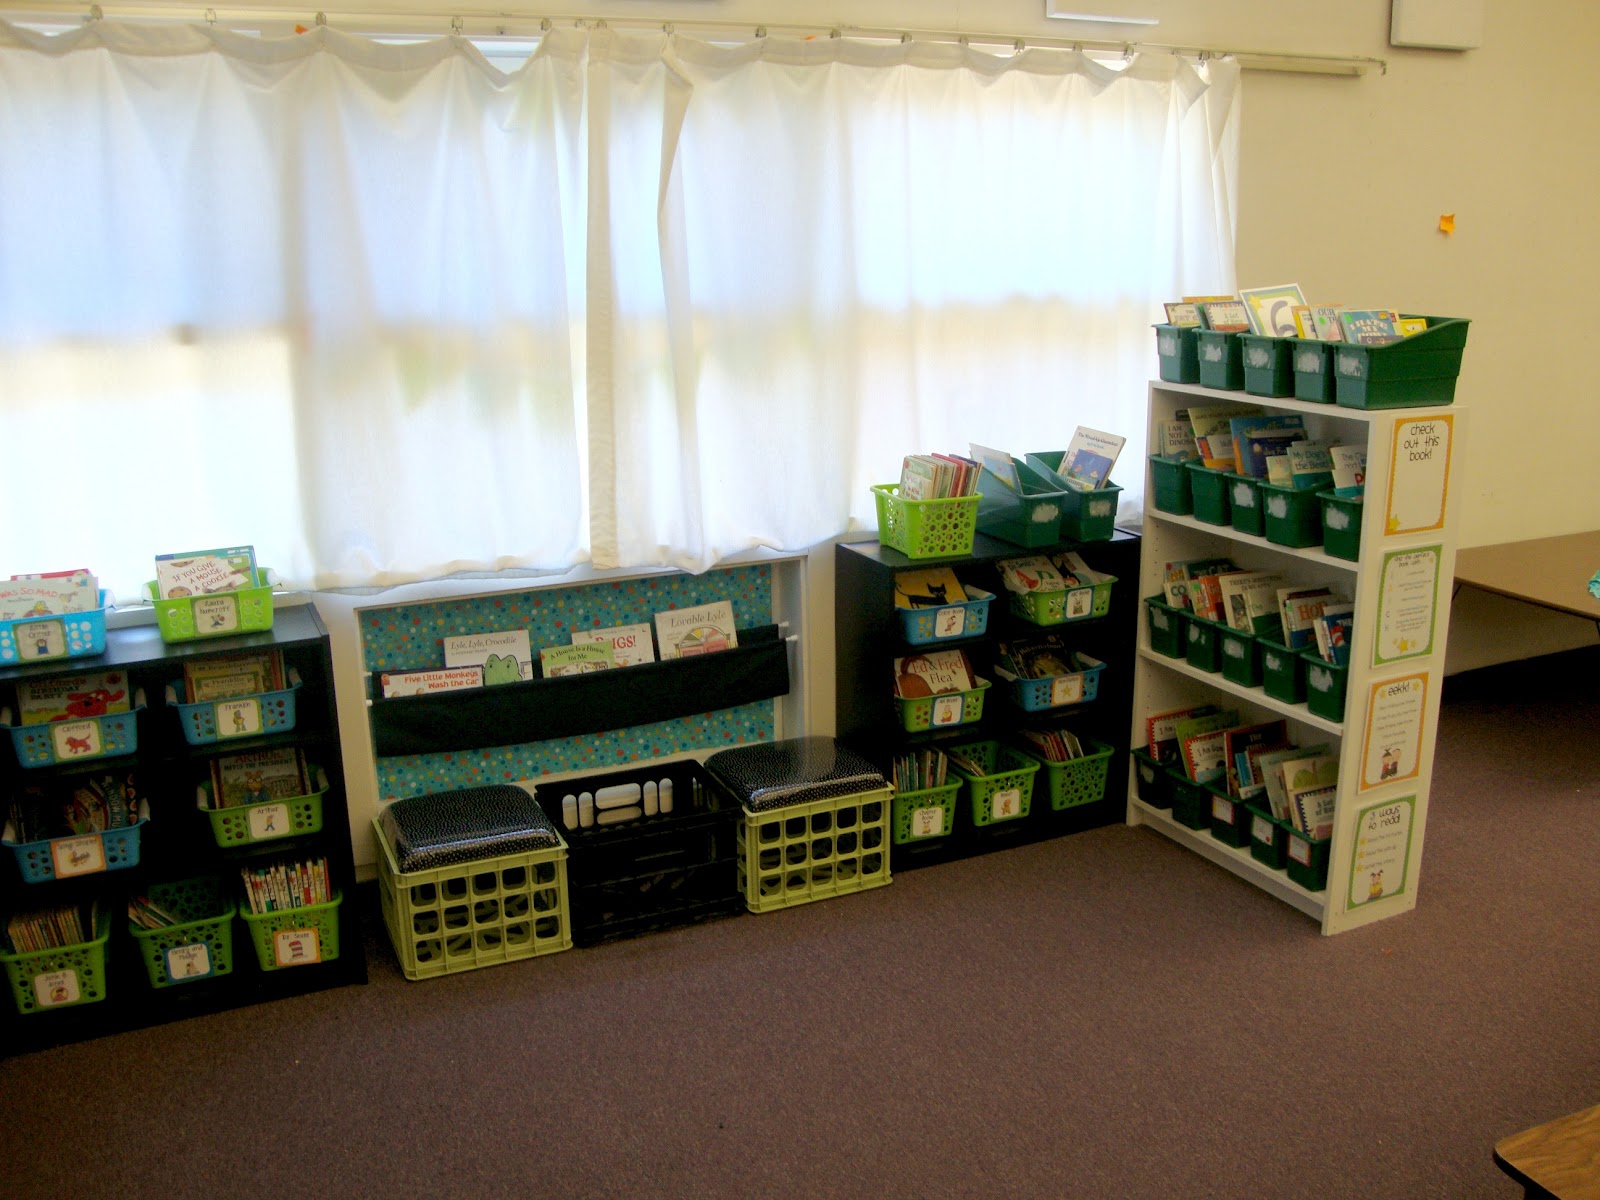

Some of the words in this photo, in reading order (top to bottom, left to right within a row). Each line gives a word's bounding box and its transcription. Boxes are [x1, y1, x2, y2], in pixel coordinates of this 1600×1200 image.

[1410, 422, 1435, 435] check
[1404, 437, 1419, 449] out
[1424, 435, 1439, 446] this
[1410, 448, 1432, 461] book!
[1295, 462, 1307, 470] the
[172, 575, 181, 583] IF
[182, 568, 196, 578] YOU
[197, 561, 216, 572] GIVE
[196, 568, 222, 582] MOUSE
[202, 573, 229, 588] COOKIE
[36, 588, 58, 598] MAD
[672, 615, 705, 628] Lovable
[708, 610, 727, 620] Lyle
[451, 640, 467, 650] Lyle,
[468, 639, 484, 648] Lyle,
[485, 636, 517, 646] Crocodile
[556, 648, 574, 657] House
[586, 645, 605, 654] House
[911, 659, 928, 673] Ed
[929, 662, 938, 670] &
[938, 656, 964, 670] Fred
[423, 674, 443, 682] Little
[445, 671, 478, 680] Monkeys
[930, 672, 953, 684] Flea
[30, 685, 79, 695] BIRTHDAY
[258, 760, 292, 768] PRESIDENT
[1379, 805, 1401, 818] ways
[1368, 822, 1376, 830] to
